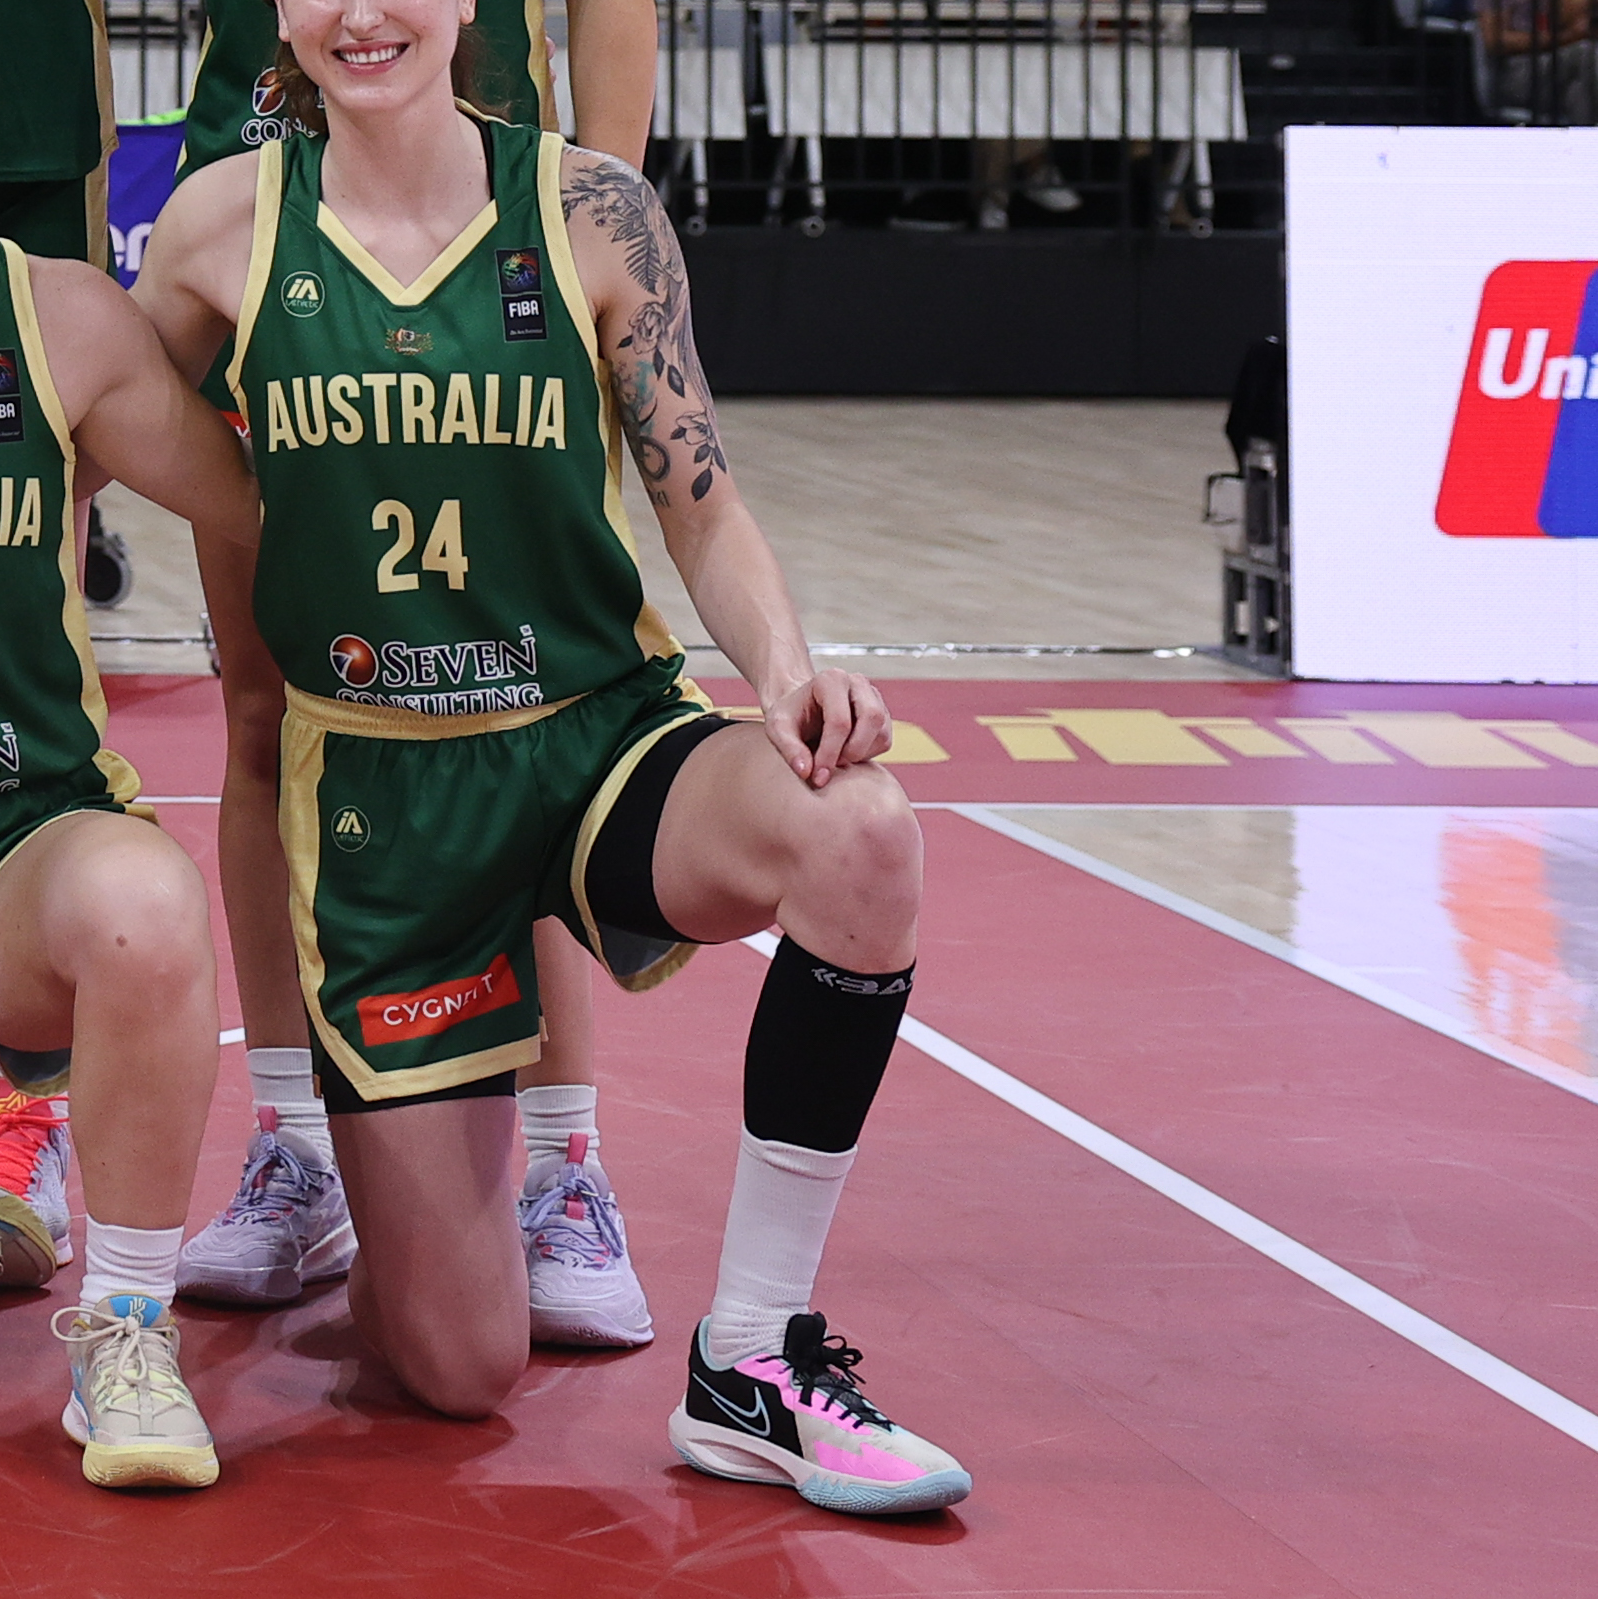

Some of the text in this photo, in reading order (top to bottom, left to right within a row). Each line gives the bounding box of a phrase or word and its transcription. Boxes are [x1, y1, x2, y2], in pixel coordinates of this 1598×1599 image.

[509, 300, 539, 318] FIBA
[266, 372, 567, 453] AUSTRALIA
[370, 499, 470, 594] 24
[381, 634, 538, 688] SEVEN
